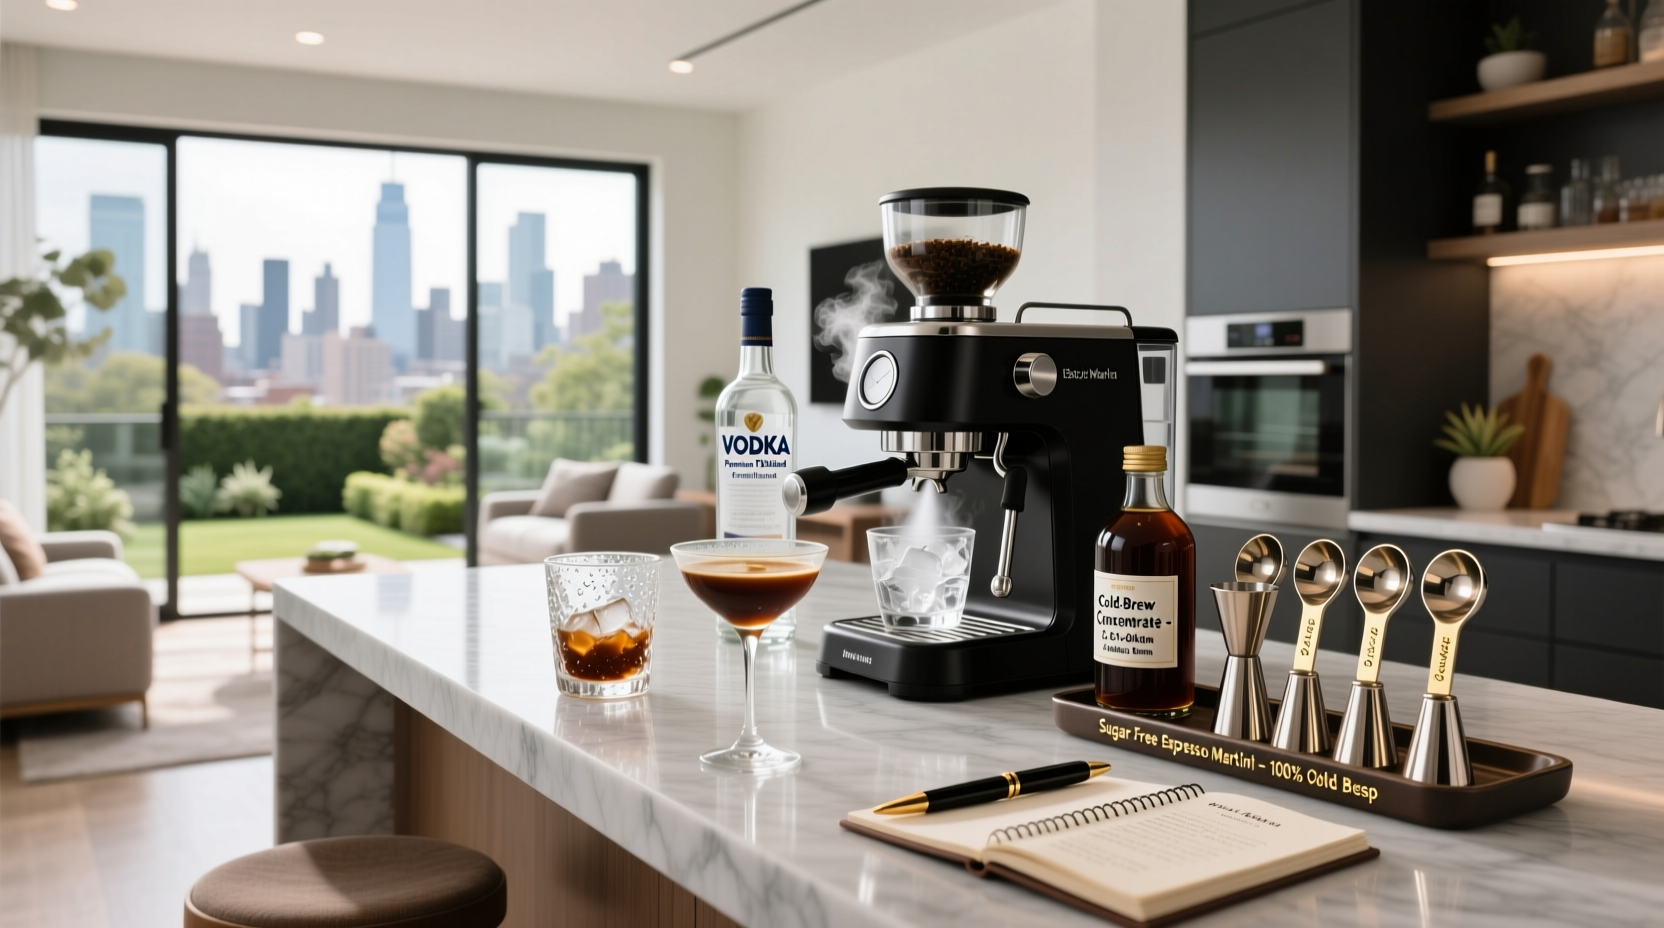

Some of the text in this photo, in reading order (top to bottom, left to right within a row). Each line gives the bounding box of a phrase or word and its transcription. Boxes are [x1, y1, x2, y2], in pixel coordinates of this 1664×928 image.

[722, 434, 791, 455] VODKA
[1099, 718, 1132, 741] Sugar
[1133, 726, 1158, 746] Free
[1269, 760, 1303, 783] 100%
